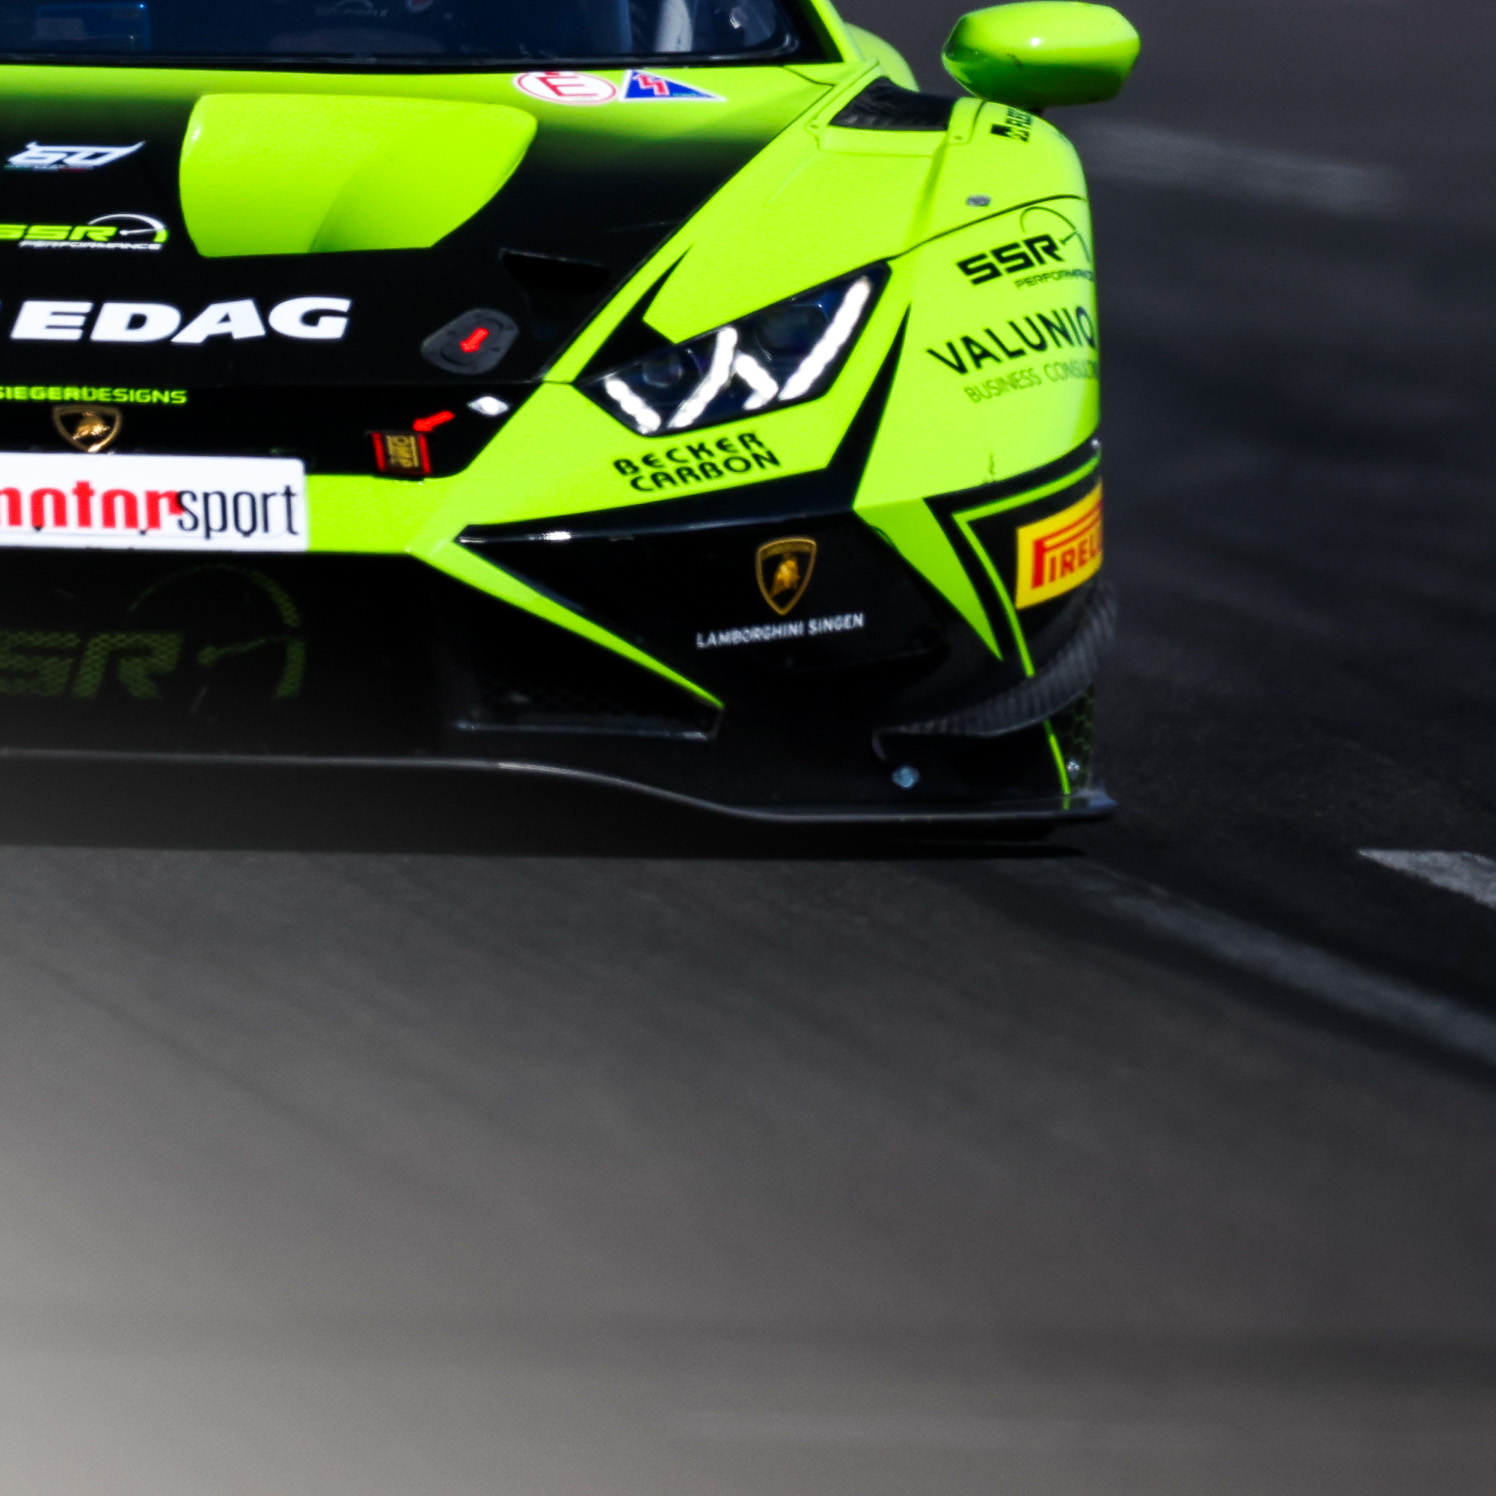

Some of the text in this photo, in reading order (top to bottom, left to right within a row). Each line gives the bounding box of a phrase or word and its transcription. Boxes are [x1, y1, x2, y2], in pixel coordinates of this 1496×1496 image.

[956, 234, 1065, 286] SSR
[9, 296, 351, 343] EDAG
[926, 306, 1097, 375] VALUNIQ
[964, 367, 1042, 404] BUSINESS
[613, 432, 765, 476] BECKER
[630, 450, 781, 492] CARBON
